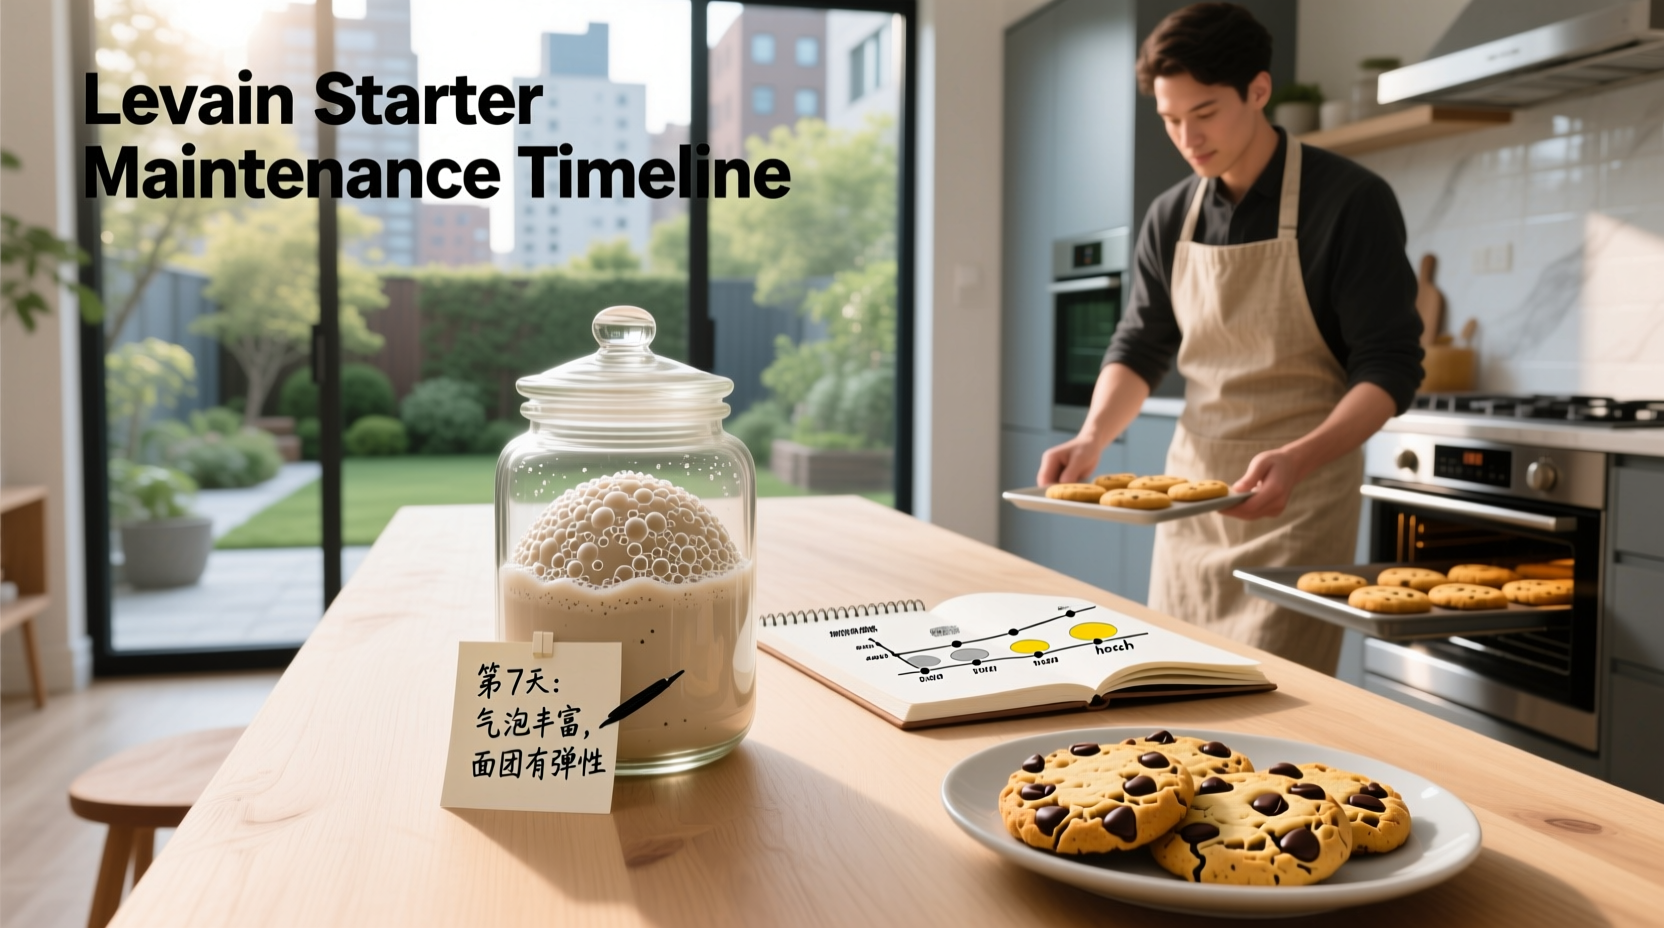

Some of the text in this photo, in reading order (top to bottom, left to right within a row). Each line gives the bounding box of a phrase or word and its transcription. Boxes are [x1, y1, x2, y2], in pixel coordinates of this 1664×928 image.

[477, 661, 560, 700] 第7天：
[476, 704, 590, 740] 气泡丰富，
[472, 746, 606, 781] 面团有弹性
